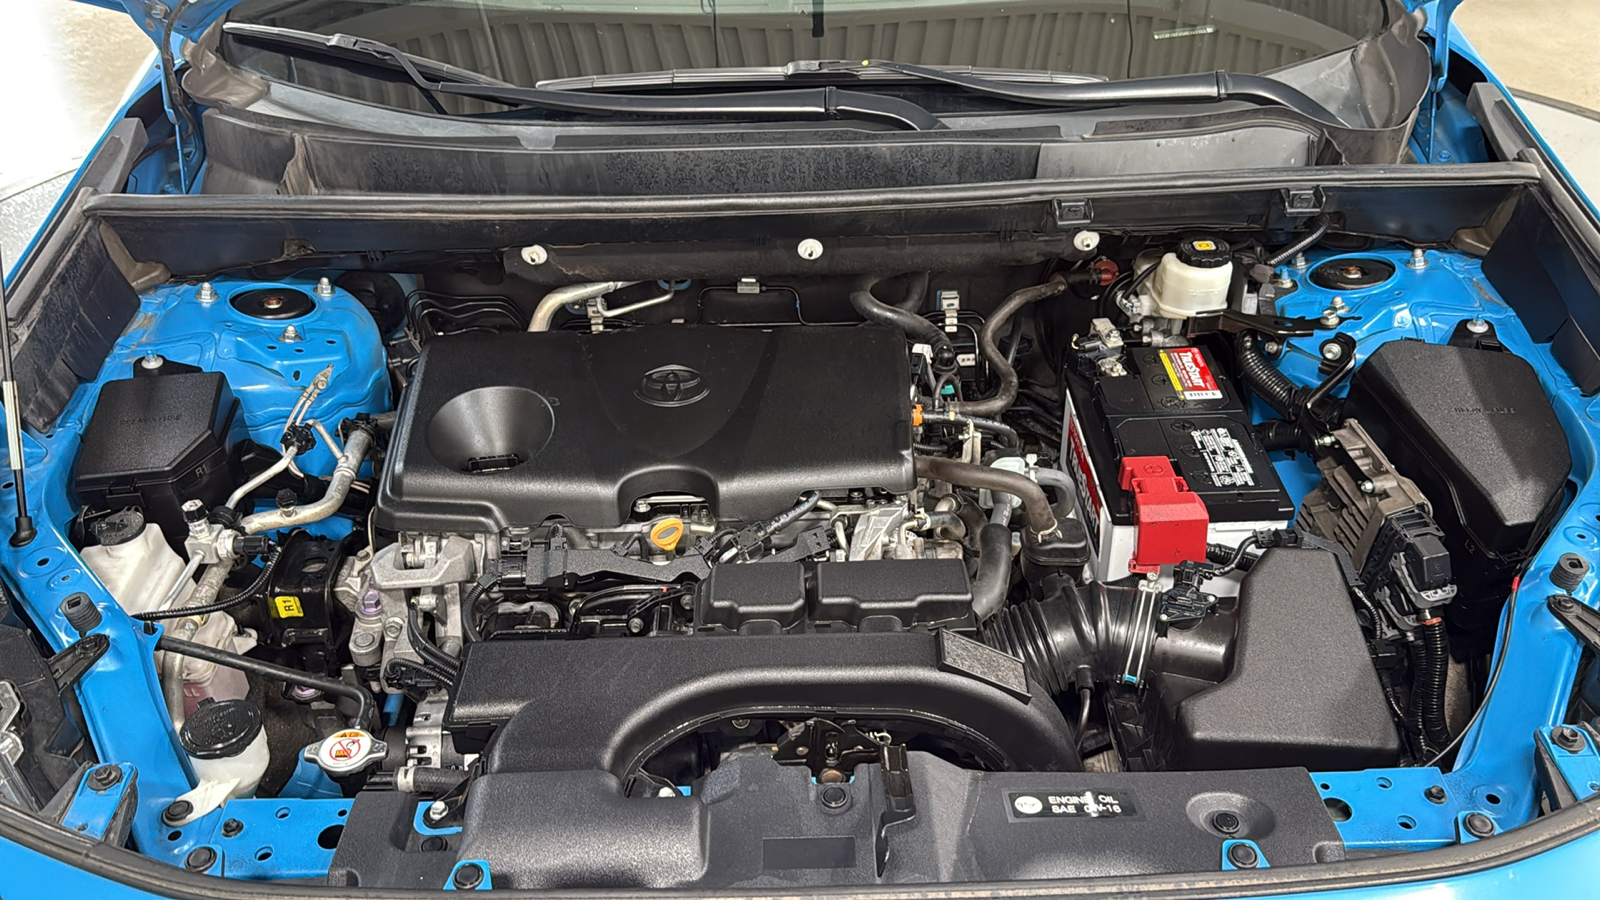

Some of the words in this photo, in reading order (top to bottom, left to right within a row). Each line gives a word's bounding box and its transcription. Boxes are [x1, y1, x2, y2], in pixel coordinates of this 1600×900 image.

[282, 600, 294, 611] R1
[1048, 795, 1090, 804] ENGINE
[1098, 794, 1119, 803] OIL
[1051, 805, 1077, 813] SAE
